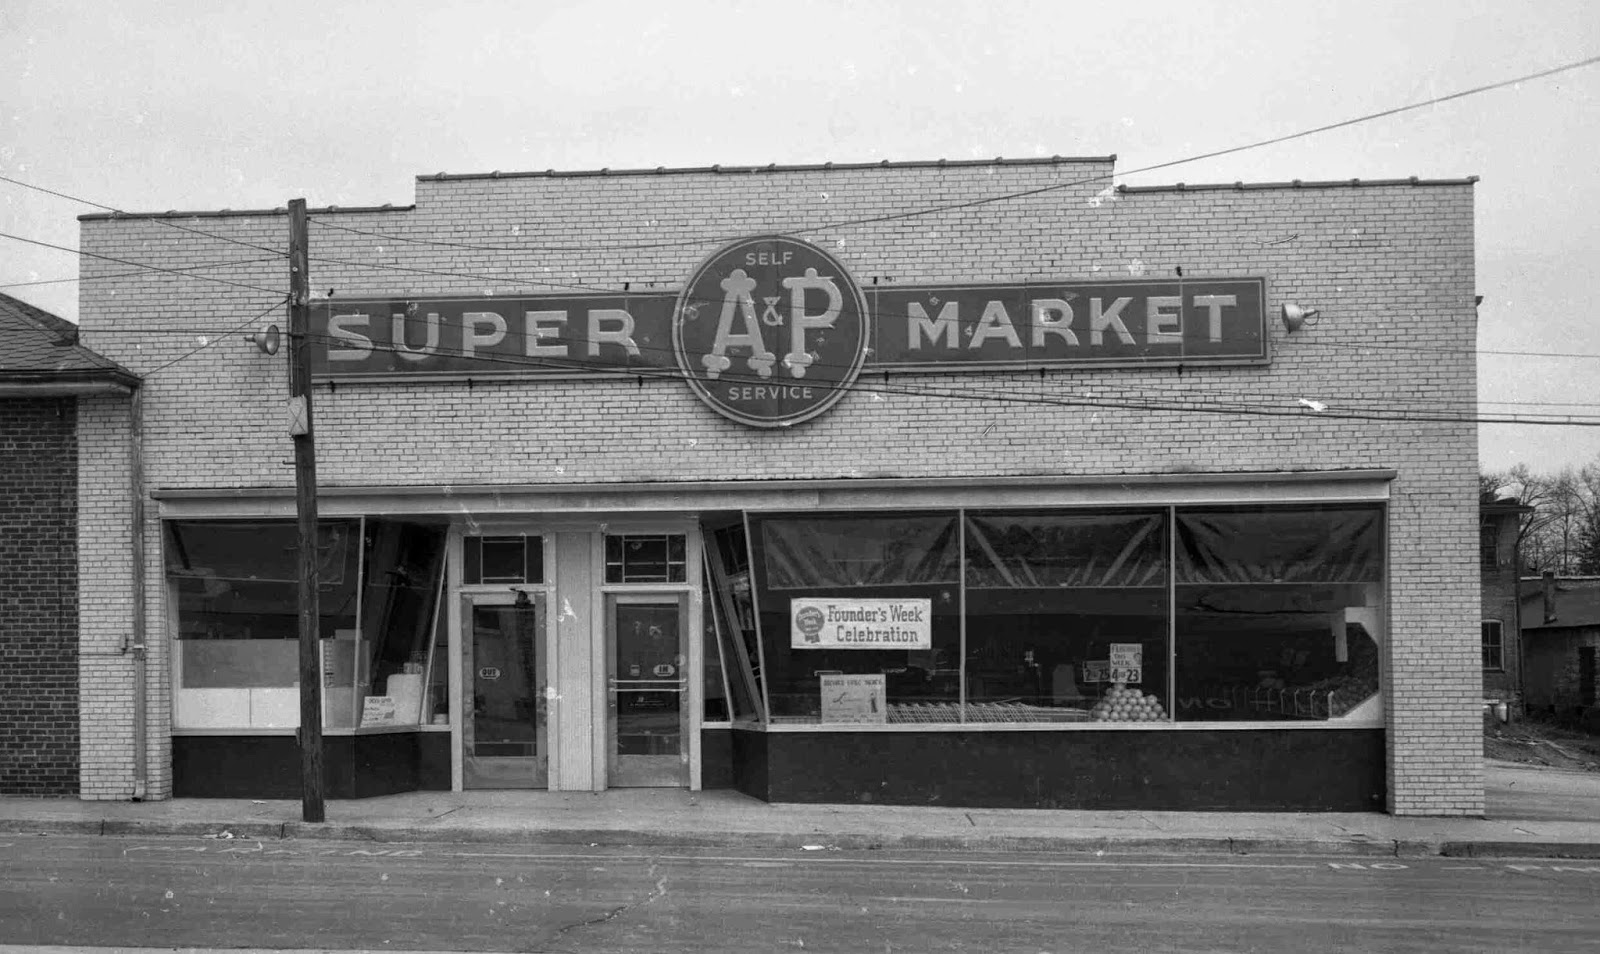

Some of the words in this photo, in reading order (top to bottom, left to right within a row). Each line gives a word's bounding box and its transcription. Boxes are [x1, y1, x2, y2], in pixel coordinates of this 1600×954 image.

[745, 252, 793, 266] SELF
[701, 267, 843, 379] A&P
[908, 295, 1237, 350] MARKET
[327, 309, 641, 361] SUPER
[728, 387, 813, 401] SERVICE
[827, 605, 887, 622] Founder's
[889, 605, 923, 622] Week
[836, 625, 919, 642] Celebration
[1127, 669, 1140, 682] 23
